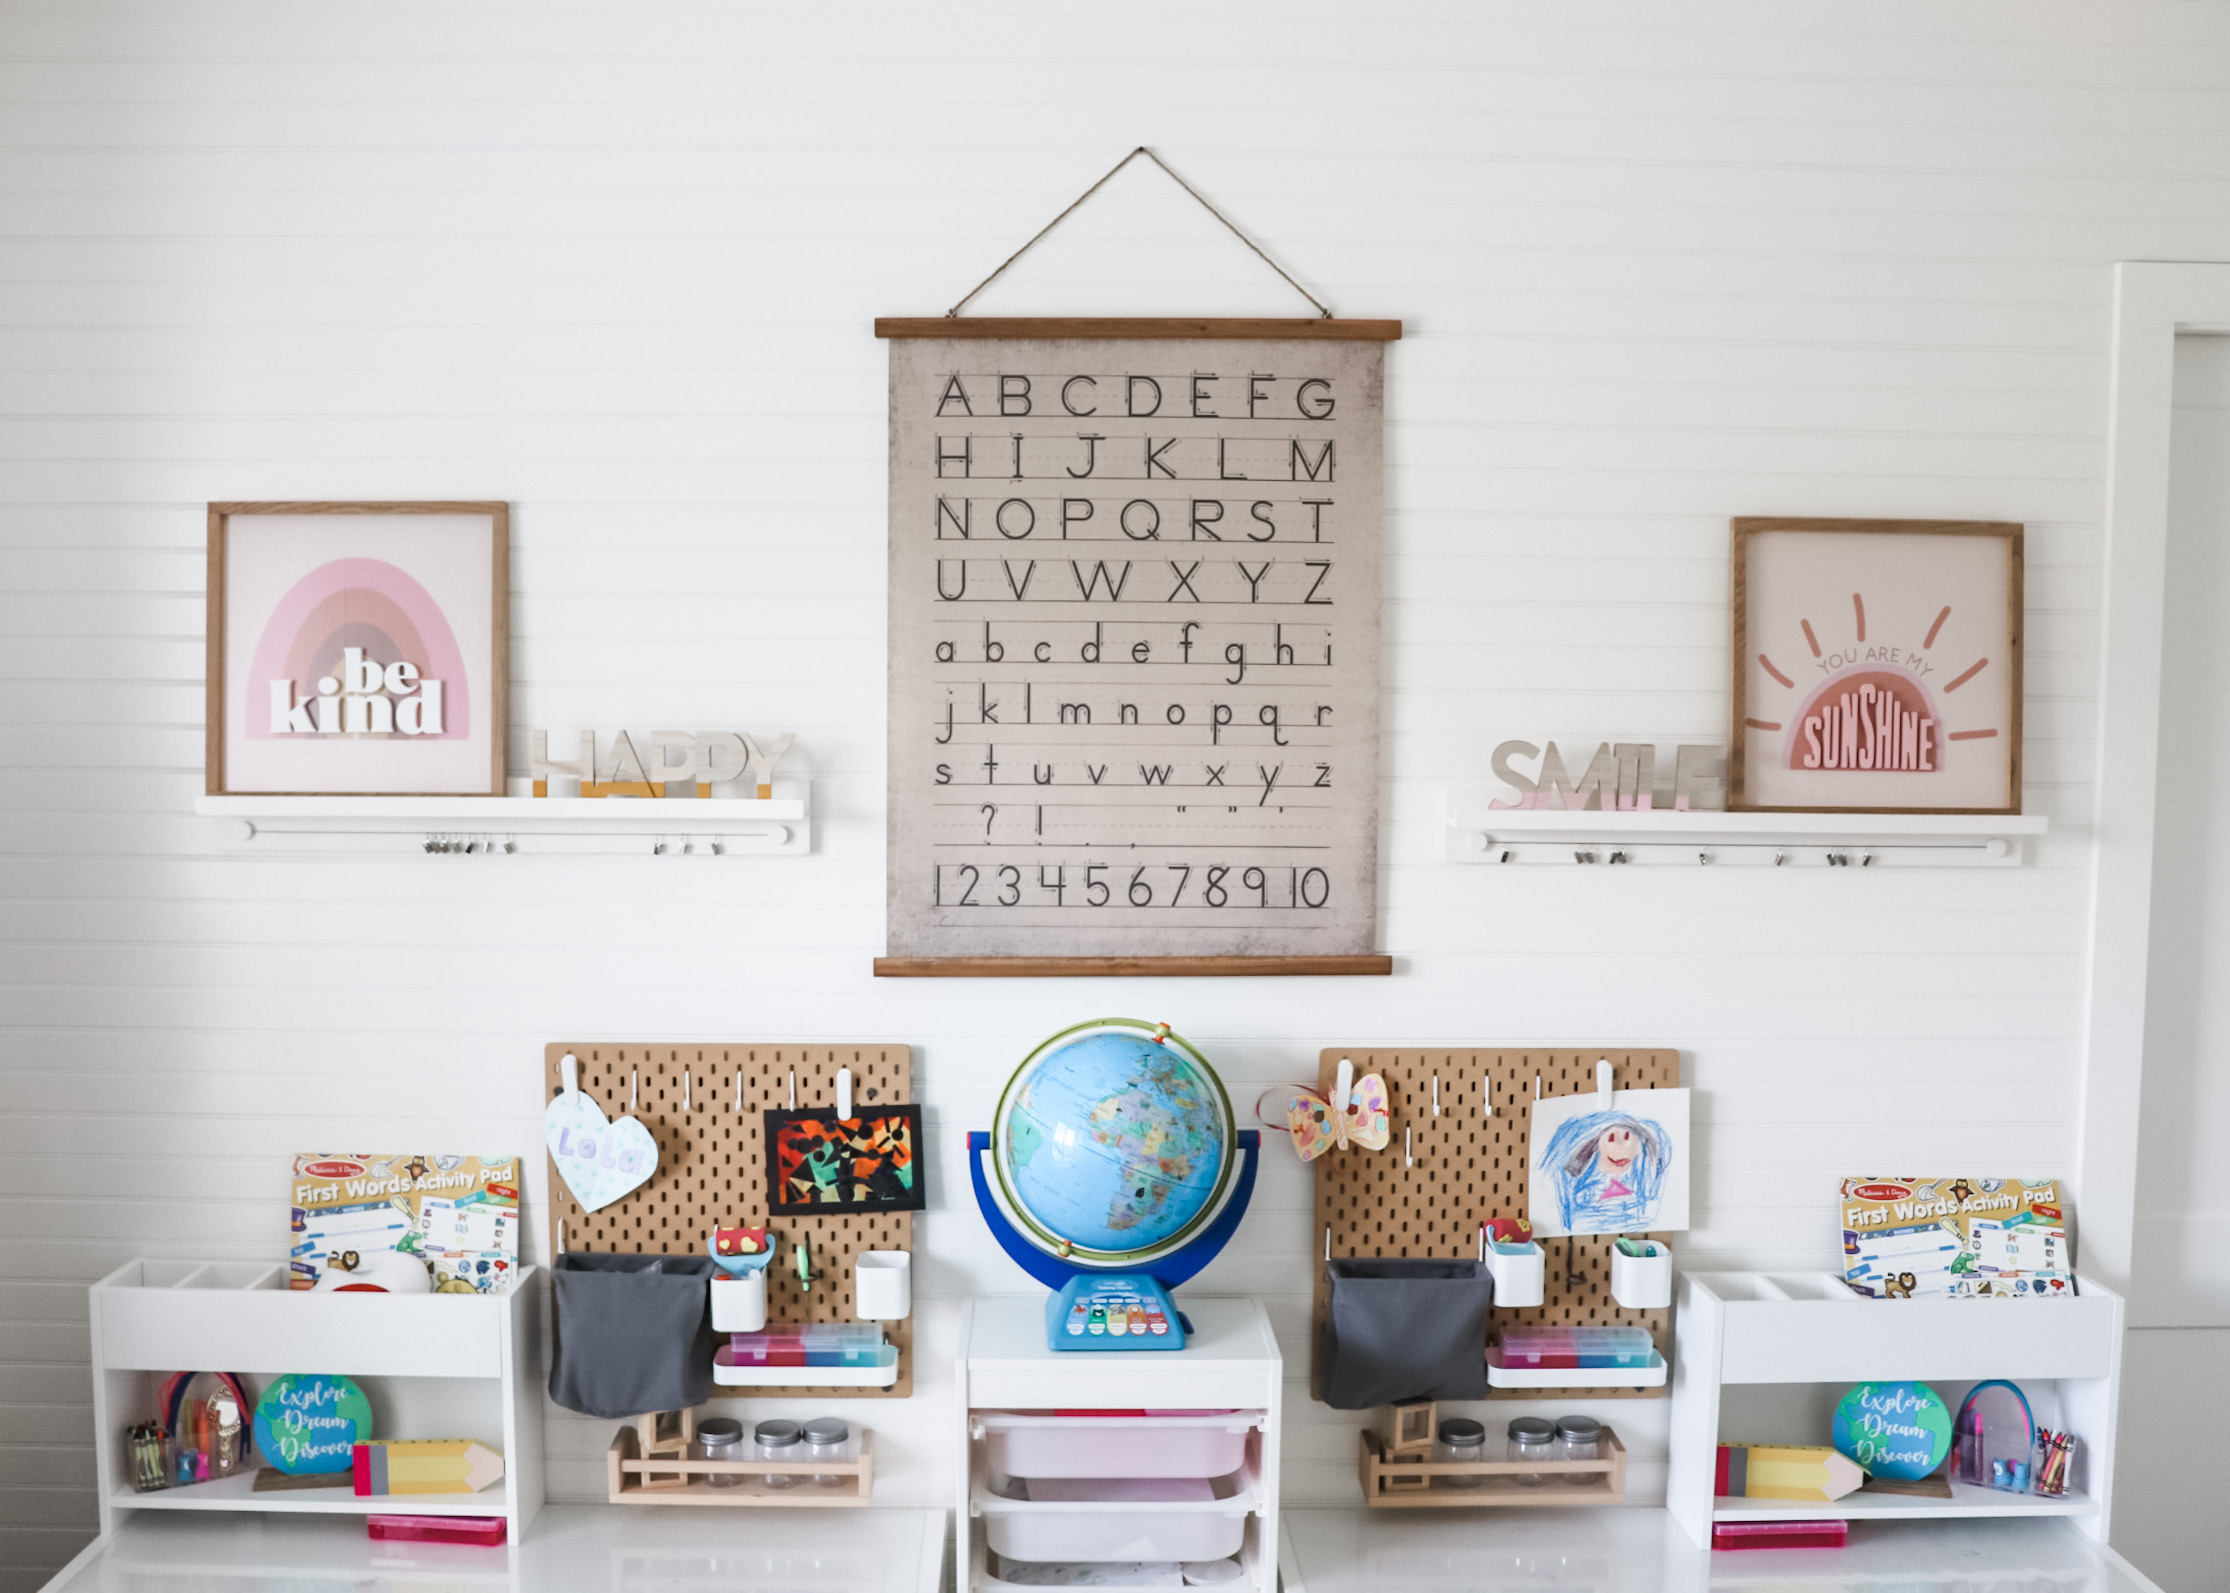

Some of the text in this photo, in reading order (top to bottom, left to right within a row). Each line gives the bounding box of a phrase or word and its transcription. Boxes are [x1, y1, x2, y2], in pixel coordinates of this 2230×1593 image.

[936, 375, 1335, 419] A B C D E F G
[937, 436, 1334, 481] H I J K L M
[937, 498, 1334, 542] N O P Q R S T
[937, 559, 1334, 604] U V W X Y Z
[344, 647, 419, 695] be
[936, 621, 1332, 684] a b c d e f g h i
[1817, 647, 1934, 676] YOU ARE MY
[269, 677, 445, 735] kind
[935, 688, 953, 744] j
[981, 683, 998, 723] k
[1060, 704, 1091, 724] m
[1121, 704, 1138, 724] n
[1167, 704, 1185, 725] o
[1213, 704, 1232, 745] p
[1259, 705, 1289, 746] q
[1317, 705, 1333, 726] r
[1803, 684, 1934, 770] SUNSHINE
[532, 729, 797, 799] HAPPY
[935, 744, 1331, 807] s t u v w x y z
[1489, 740, 1727, 811] SMILE
[959, 865, 980, 906] 2
[998, 865, 1021, 906] 3
[1039, 865, 1066, 906] 4
[1086, 865, 1110, 906] 5
[1129, 866, 1153, 906] 6
[1168, 866, 1191, 906] 7
[1205, 866, 1230, 907] 8
[1243, 866, 1265, 907] 9
[1291, 866, 1330, 908] 10
[297, 1165, 513, 1203] First Words Activity Pad
[1847, 1188, 2055, 1226] First Words Activity Pad
[276, 1381, 349, 1410] Explore
[1858, 1386, 1931, 1414] Explore
[278, 1410, 349, 1434] Dream
[1858, 1413, 1928, 1438] Dream
[273, 1436, 353, 1462] Discover
[1851, 1439, 1931, 1466] Discover
